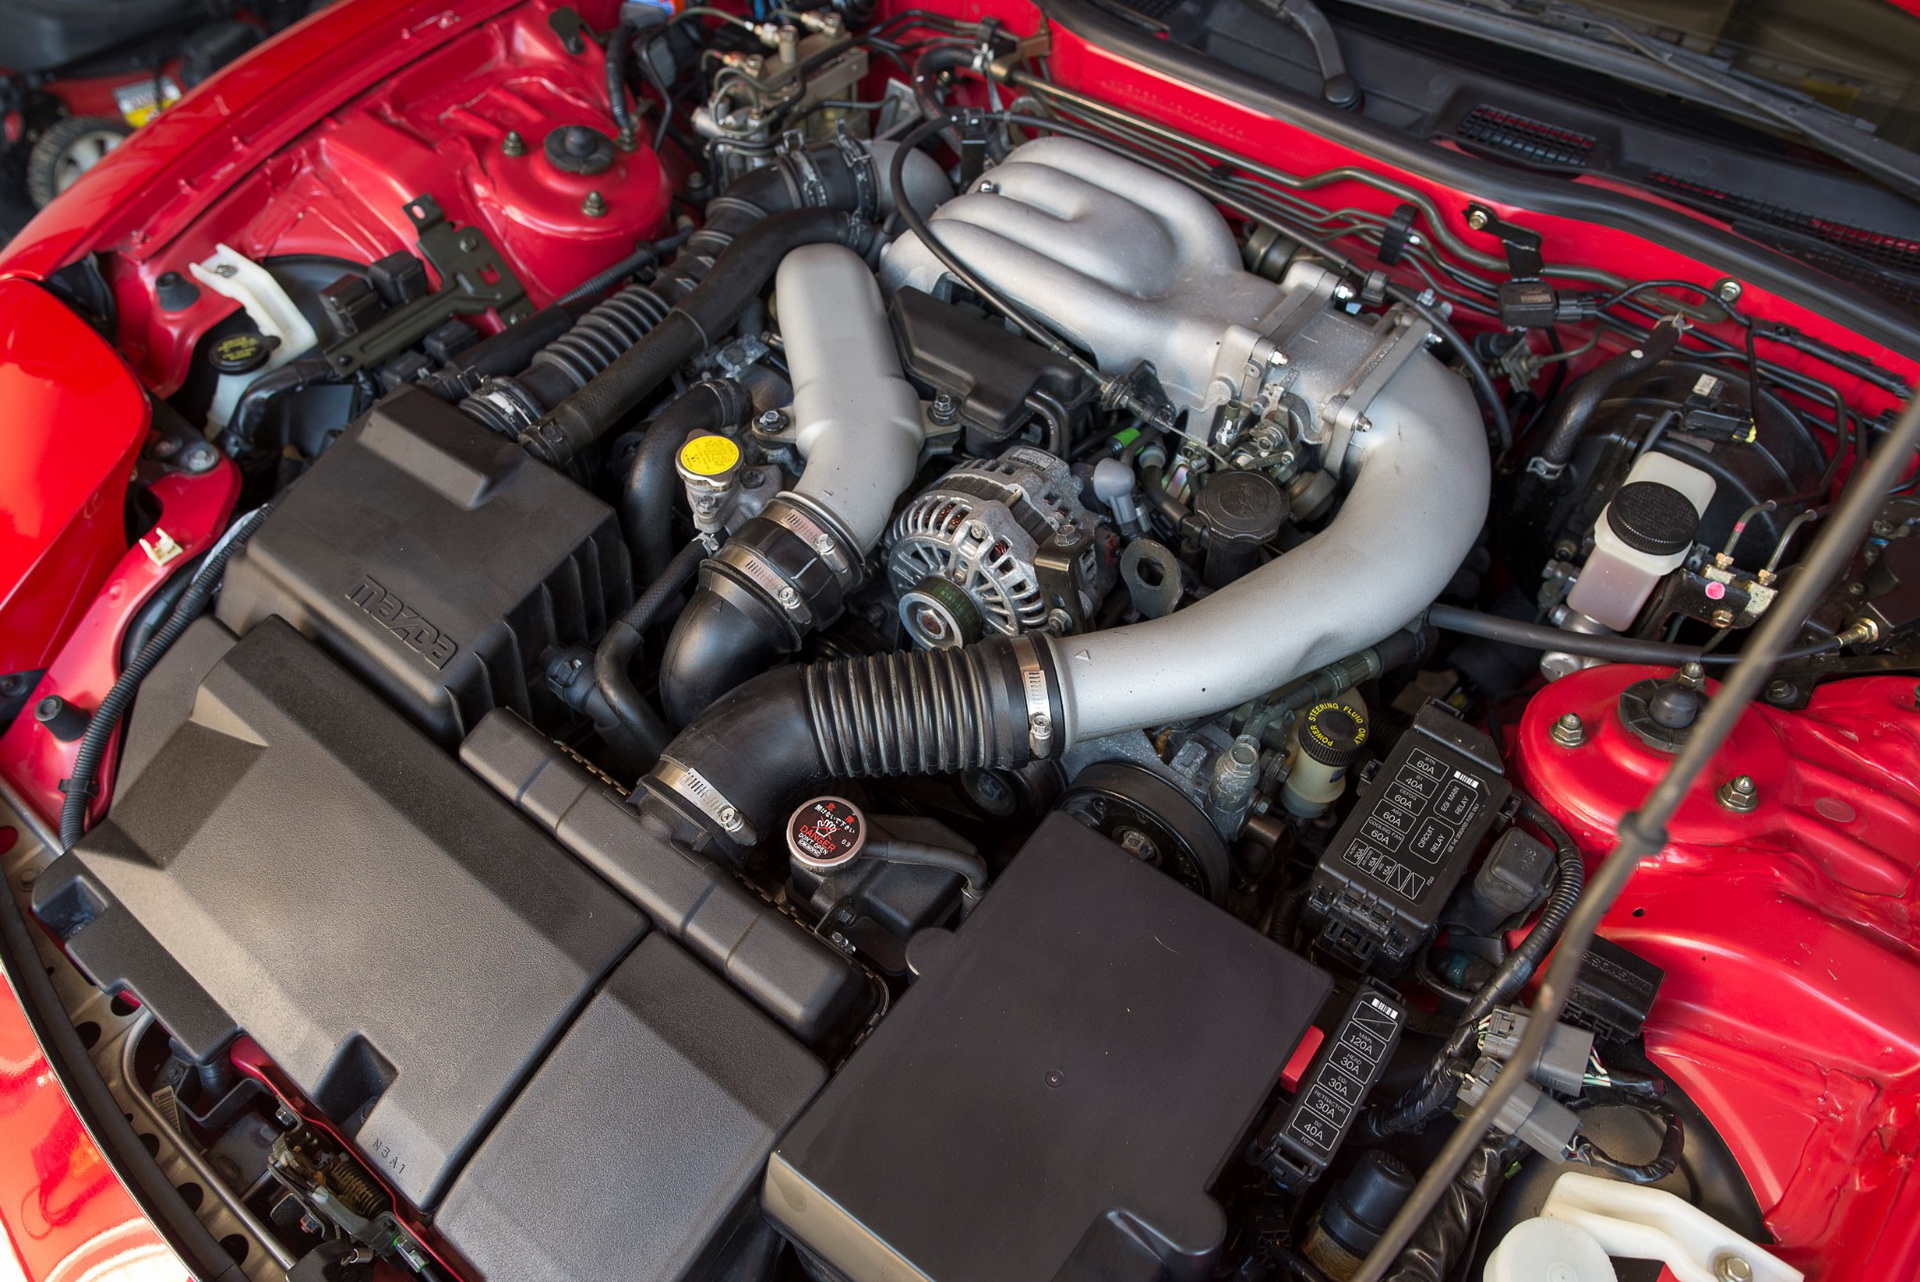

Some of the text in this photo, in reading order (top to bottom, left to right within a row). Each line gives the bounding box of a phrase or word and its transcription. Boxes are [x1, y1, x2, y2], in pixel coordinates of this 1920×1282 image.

[345, 574, 458, 671] mazda
[1308, 702, 1366, 746] POWER STEERING FLUID ONLY
[1416, 760, 1435, 774] 60A
[1406, 778, 1424, 792] 40A
[1399, 788, 1417, 800] DEFOG
[1448, 786, 1460, 801] MAIN
[1394, 794, 1413, 809] 60A
[1455, 796, 1470, 816] RELAY
[1383, 812, 1401, 826] 60A
[1391, 808, 1402, 816] ABS
[1368, 819, 1402, 841] COOLING FAN
[1371, 830, 1389, 845] 60A
[1417, 825, 1435, 849] CIRCUIT
[800, 825, 836, 852] DANGER
[841, 839, 851, 847] 0.9
[1430, 833, 1446, 854] RELAY
[814, 842, 828, 855] OPEN
[1368, 857, 1378, 867] 15A
[1382, 865, 1392, 876] 15A
[1350, 1034, 1373, 1055] 120A
[1358, 1032, 1373, 1044] MAIN
[1340, 1056, 1360, 1075] 30A
[1346, 1053, 1362, 1065] HEAD
[1328, 1078, 1348, 1097] 30A
[1314, 1090, 1347, 1114] RETRACTOR
[1315, 1100, 1335, 1118] 30A
[1304, 1123, 1324, 1141] 40A
